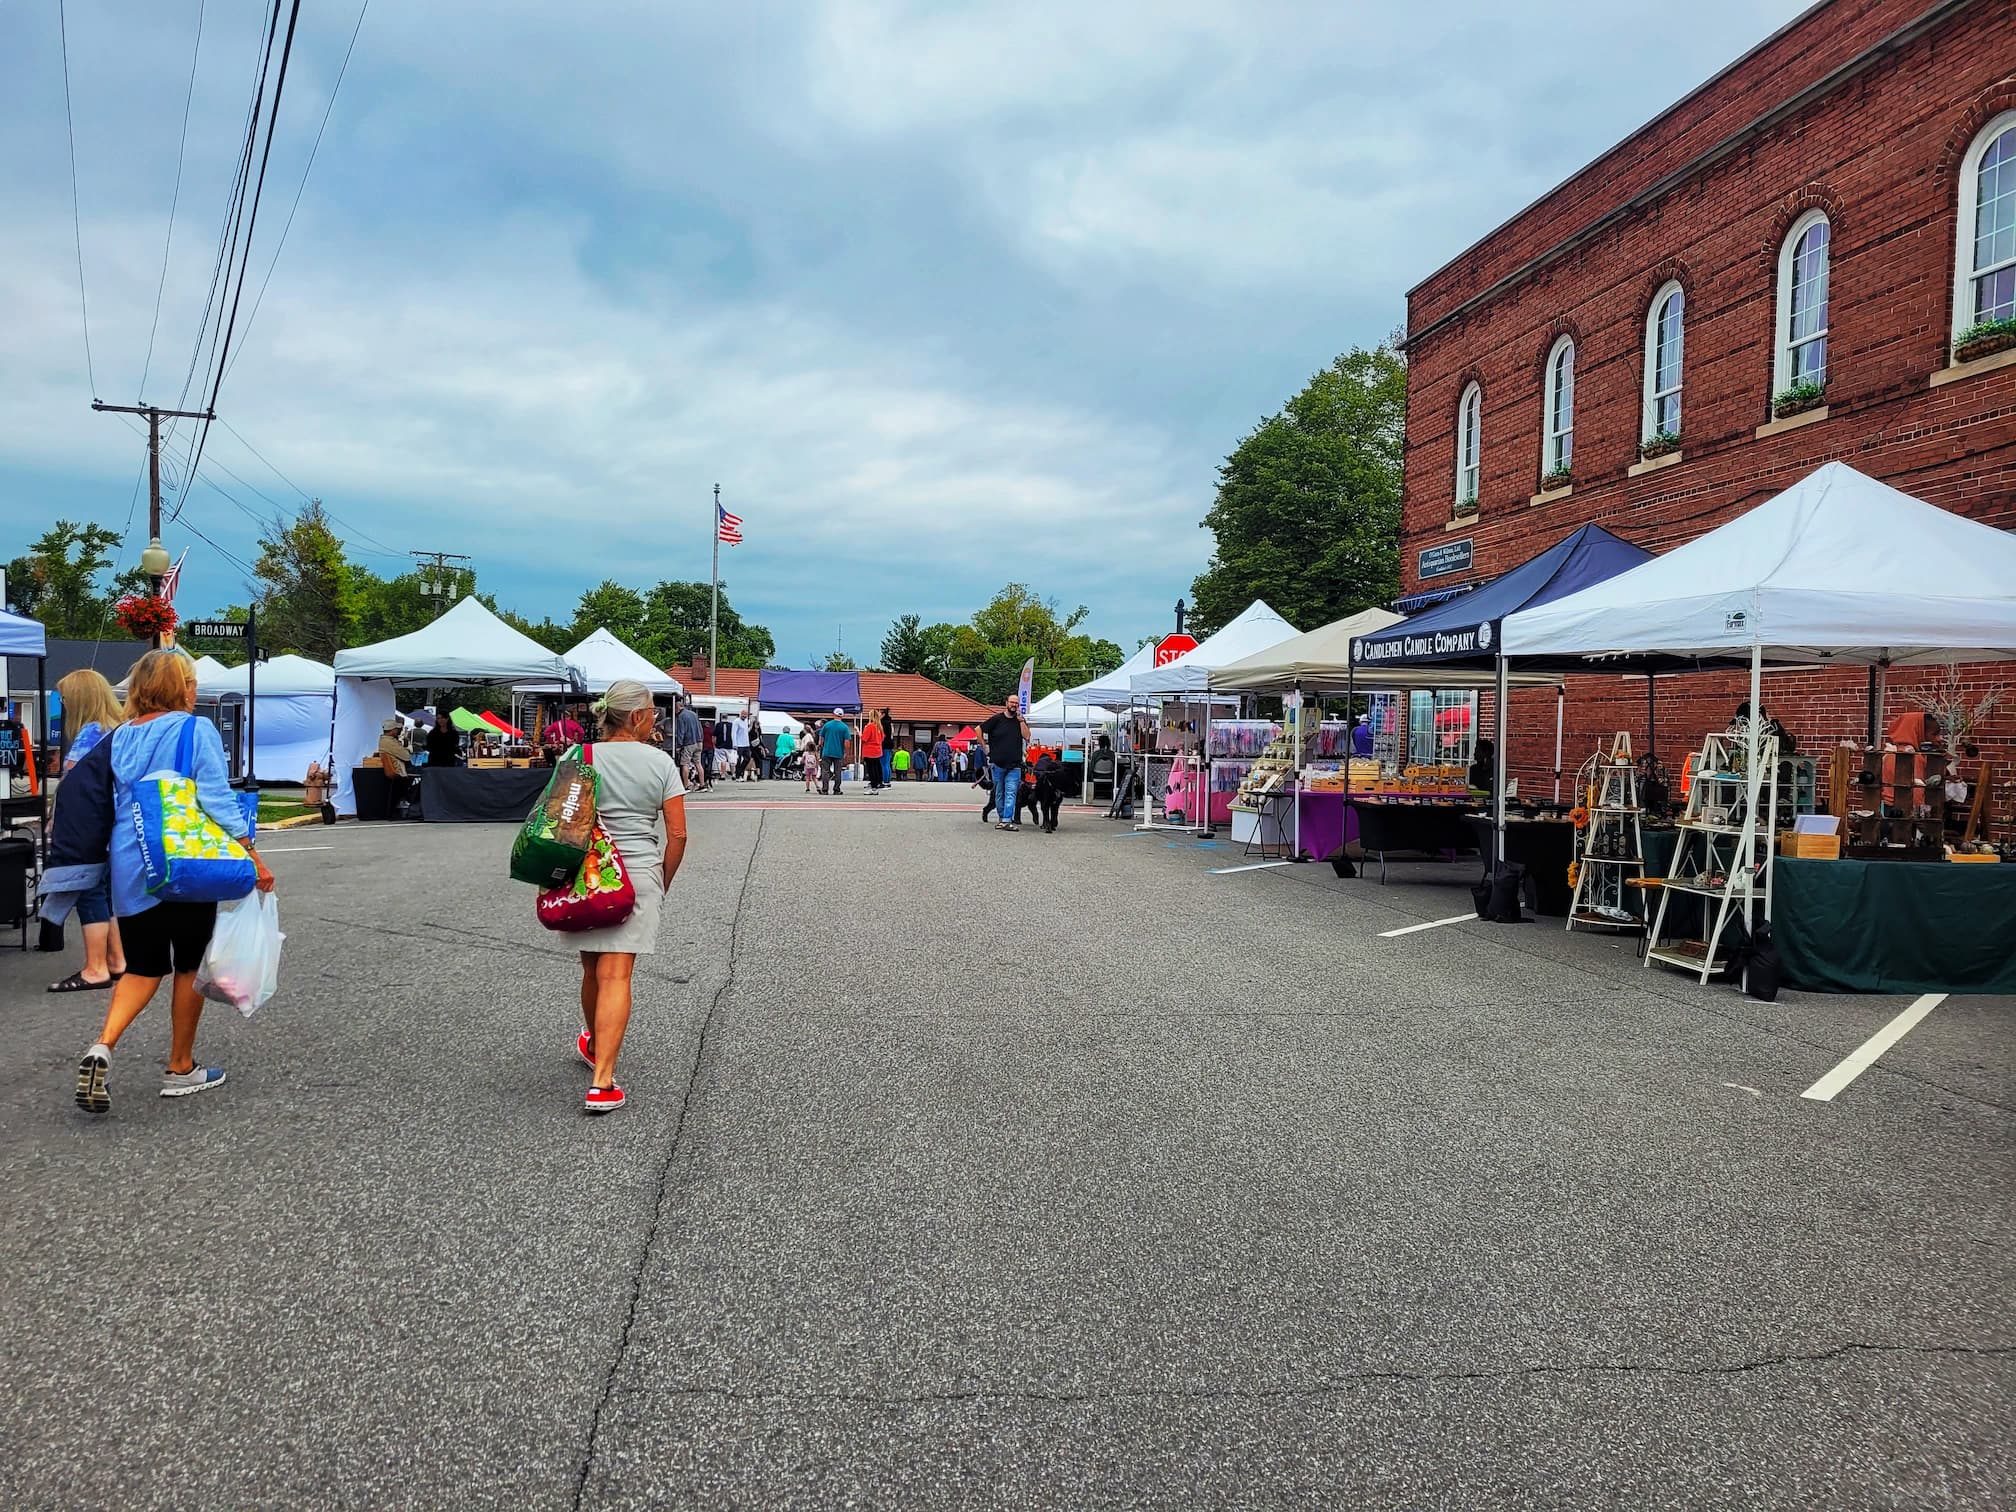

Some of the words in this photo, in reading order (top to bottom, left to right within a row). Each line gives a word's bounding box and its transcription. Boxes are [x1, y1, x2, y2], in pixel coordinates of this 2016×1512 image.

[1444, 551, 1470, 563] Booksellers
[194, 624, 245, 637] BROADWAY
[1159, 649, 1188, 665] ST
[1364, 640, 1403, 660] CANDLEMEN
[1404, 636, 1433, 656] CANDLE
[1434, 632, 1476, 653] COMPANY
[561, 782, 582, 824] meijer
[132, 802, 158, 879] HomeGoods
